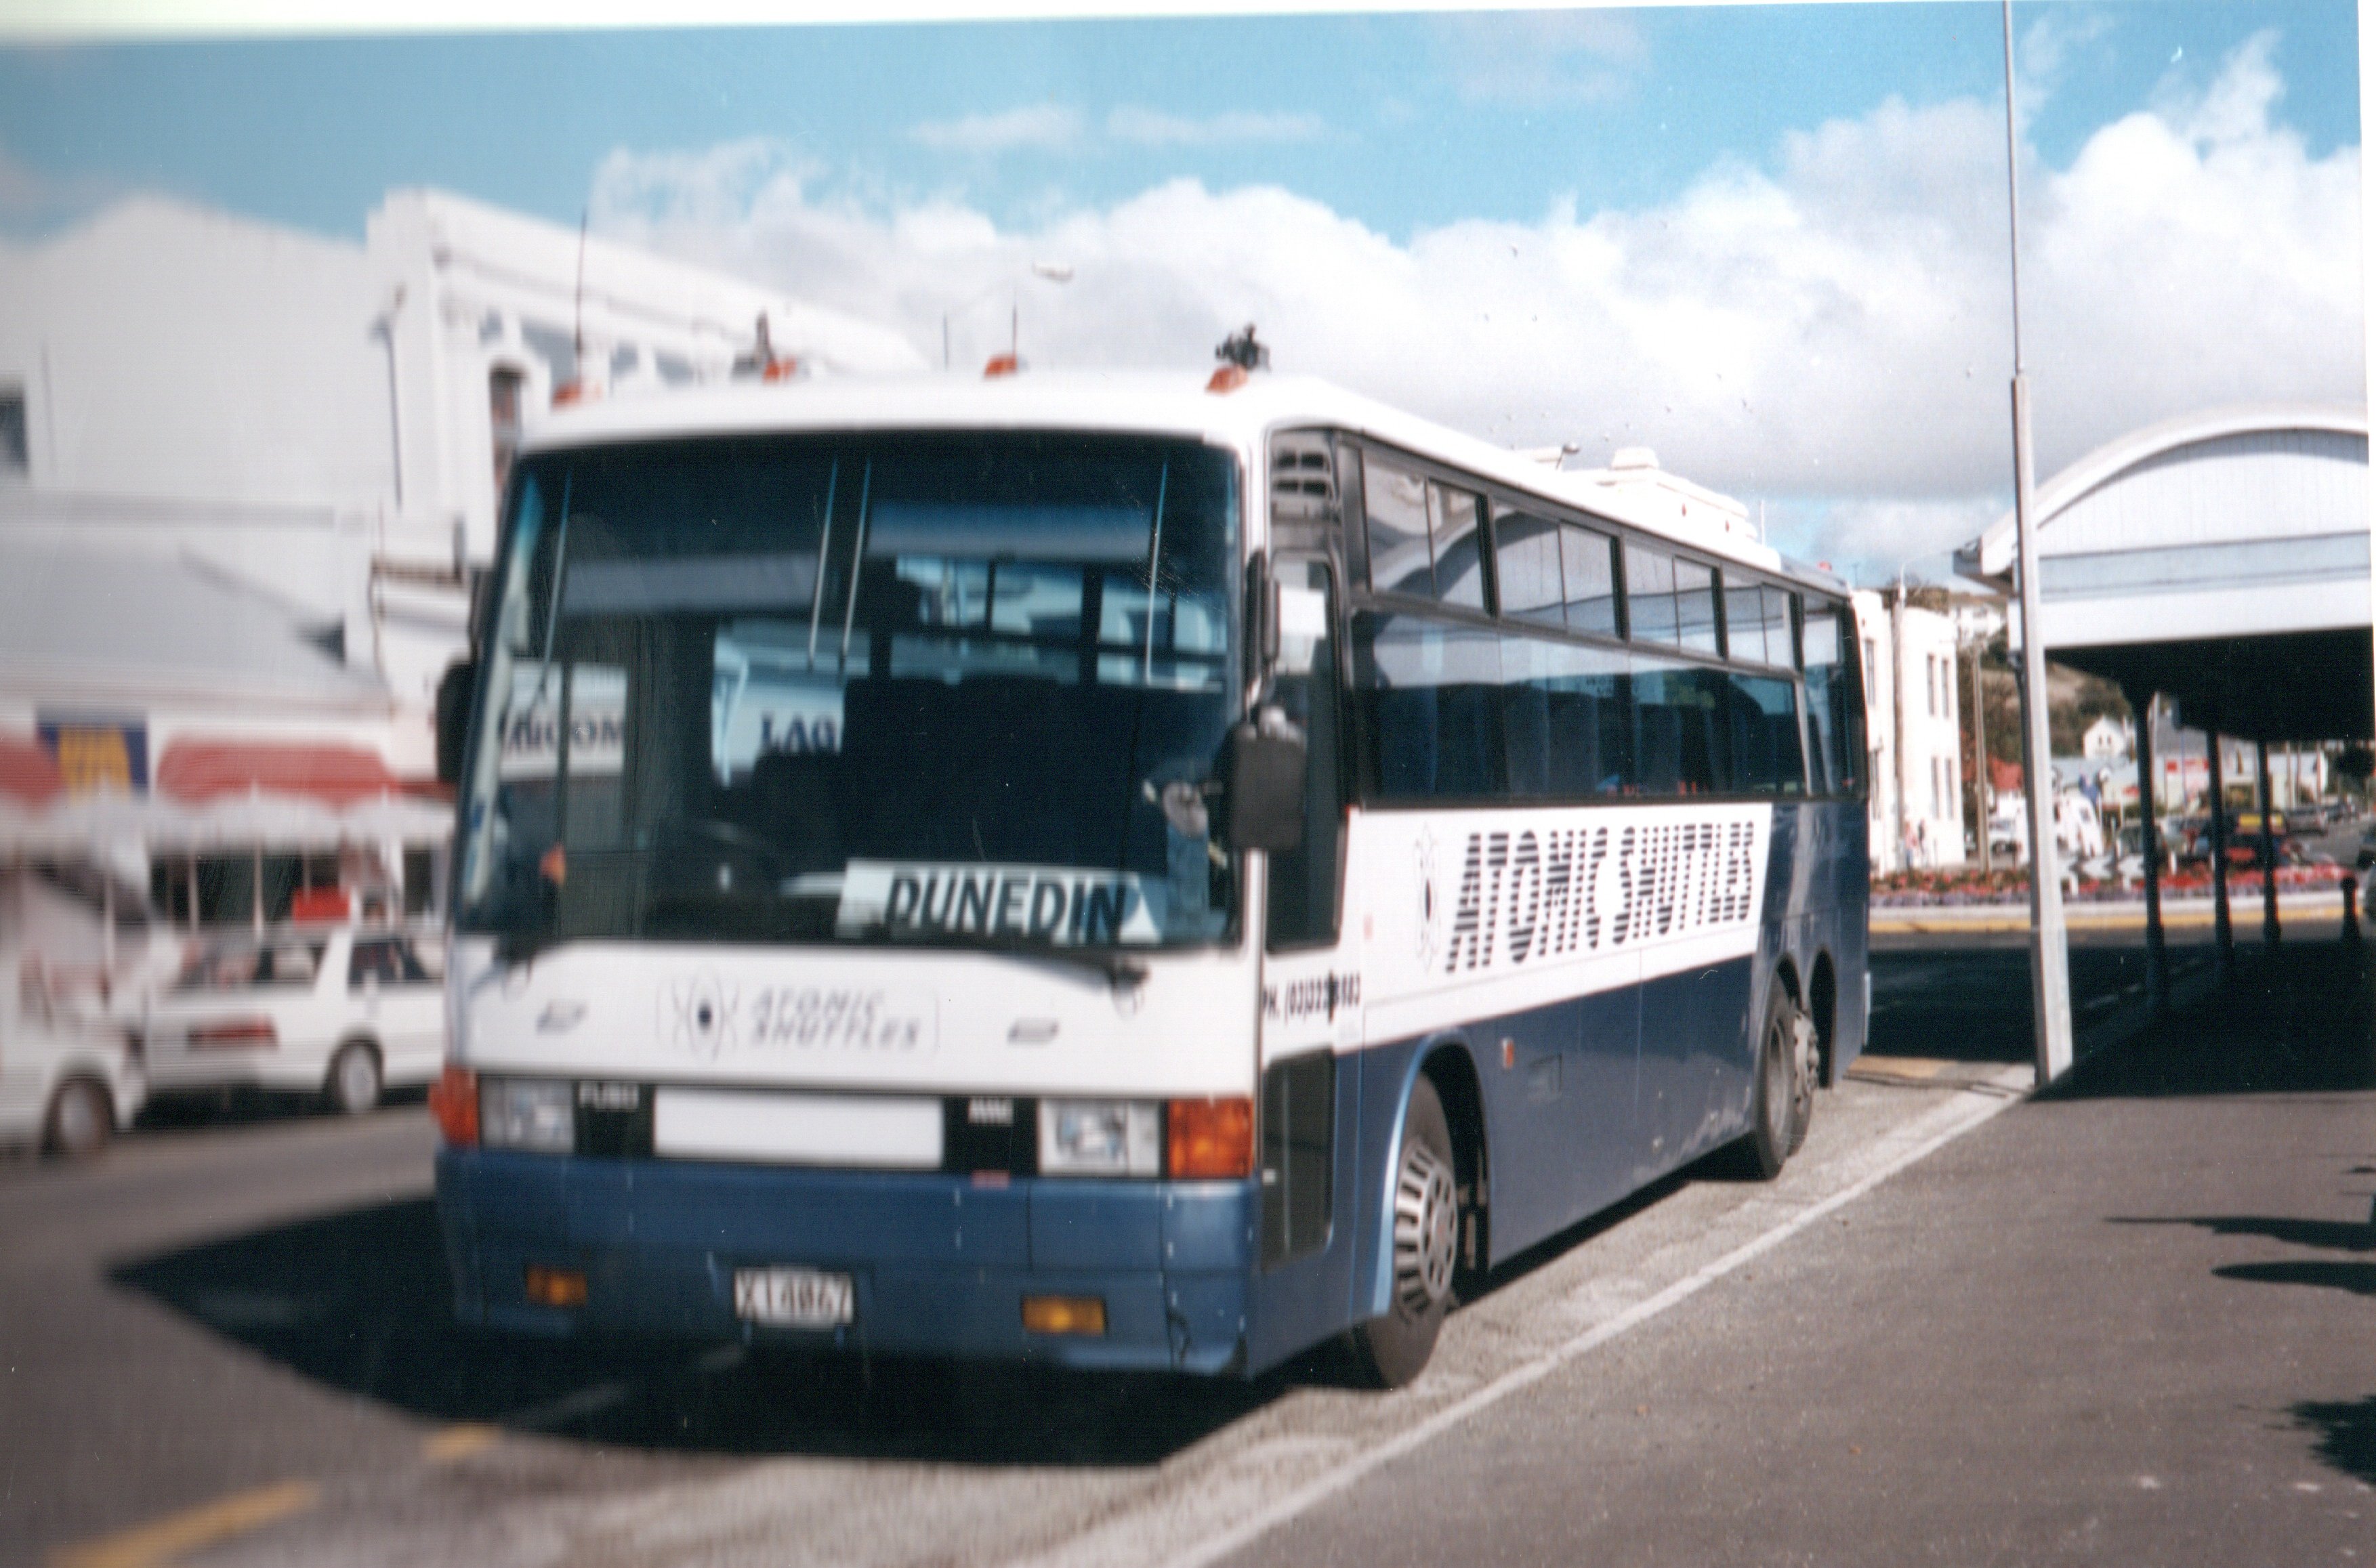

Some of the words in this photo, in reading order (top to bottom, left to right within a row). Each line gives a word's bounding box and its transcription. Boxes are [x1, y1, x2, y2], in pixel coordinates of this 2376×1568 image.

[884, 873, 1128, 944] DUNEDIN
[1445, 826, 1608, 973] ATOMIC
[1612, 821, 1753, 944] SHUTTLES
[753, 988, 885, 1016] ATOMIC
[749, 1016, 920, 1049] SHUTTLES
